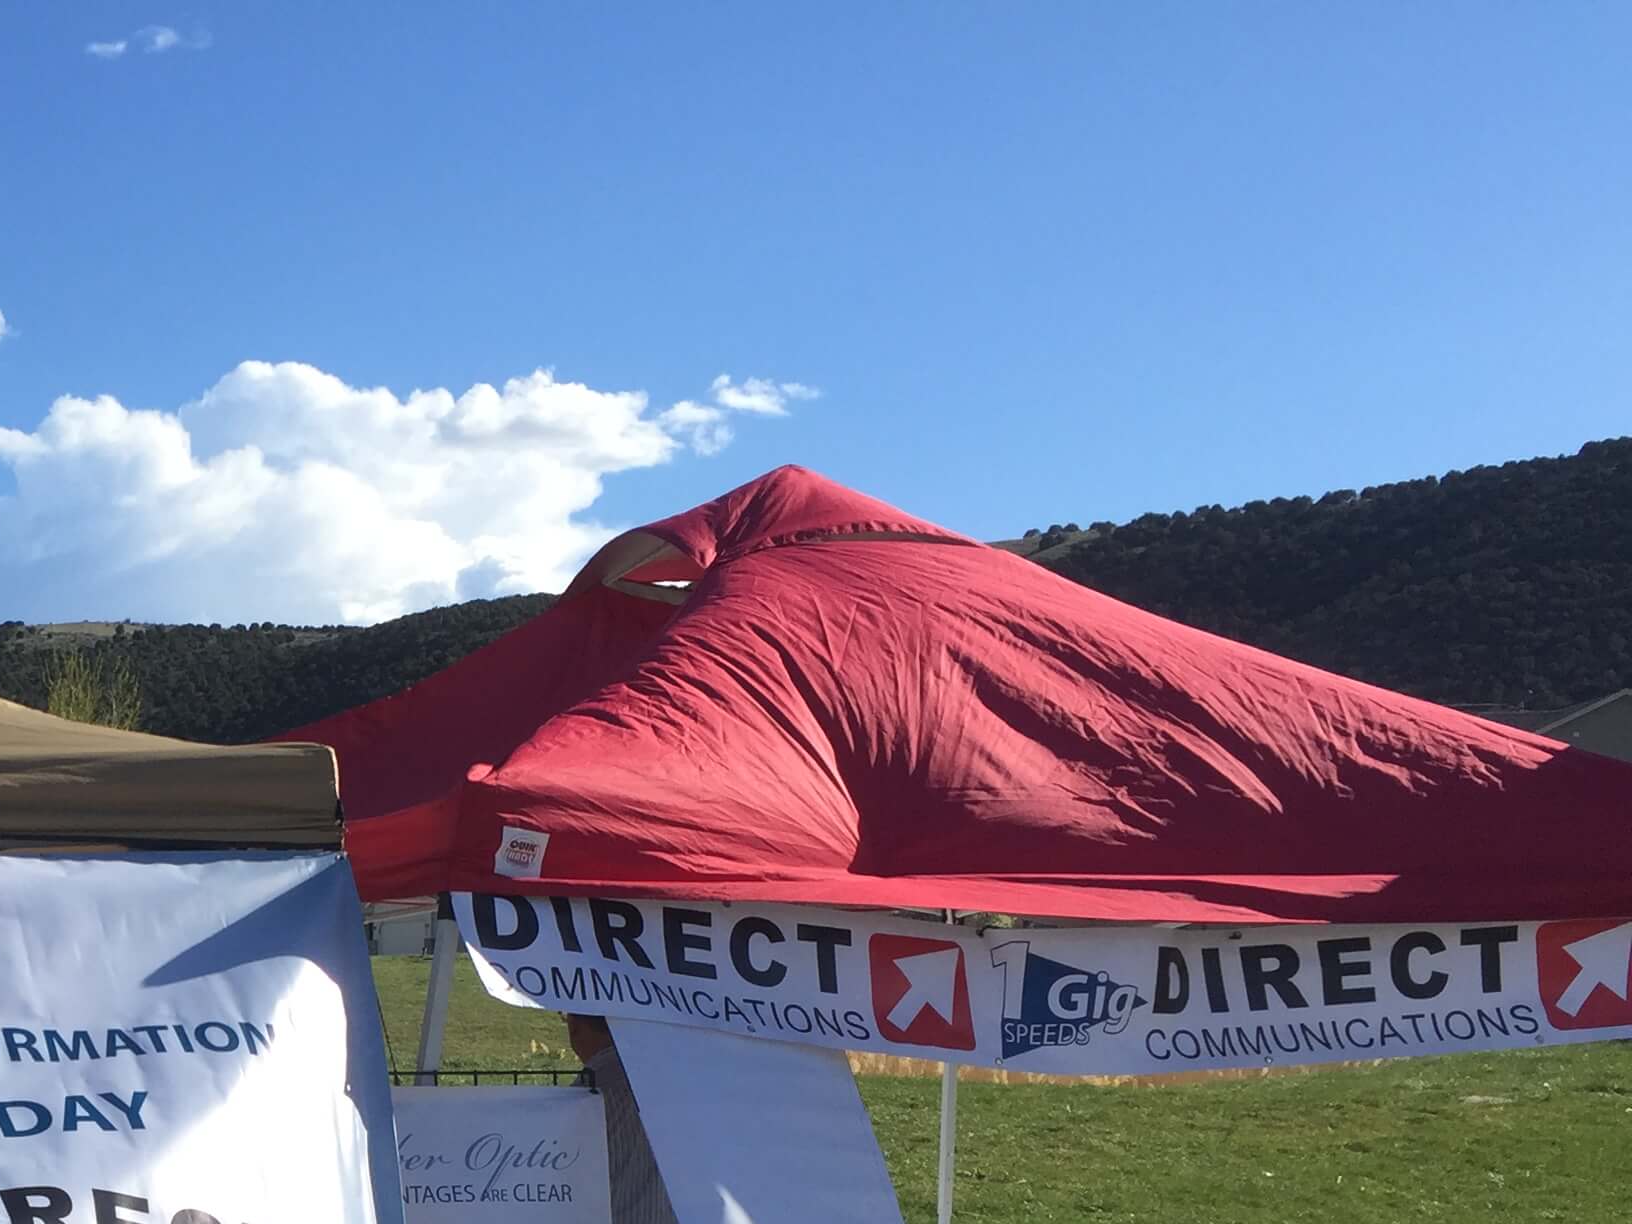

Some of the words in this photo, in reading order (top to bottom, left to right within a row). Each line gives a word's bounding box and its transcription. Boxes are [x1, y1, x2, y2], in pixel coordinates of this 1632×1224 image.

[471, 891, 852, 994] DIRECT
[1153, 924, 1518, 1015] DIRECT
[1047, 970, 1138, 1034] Gig
[1145, 1004, 1540, 1061] COMMUNICATIONS
[1004, 1022, 1091, 1047] SPEEDS
[464, 1132, 583, 1202] Optic
[482, 1188, 508, 1202] ARE
[513, 1183, 572, 1203] CLEAR
